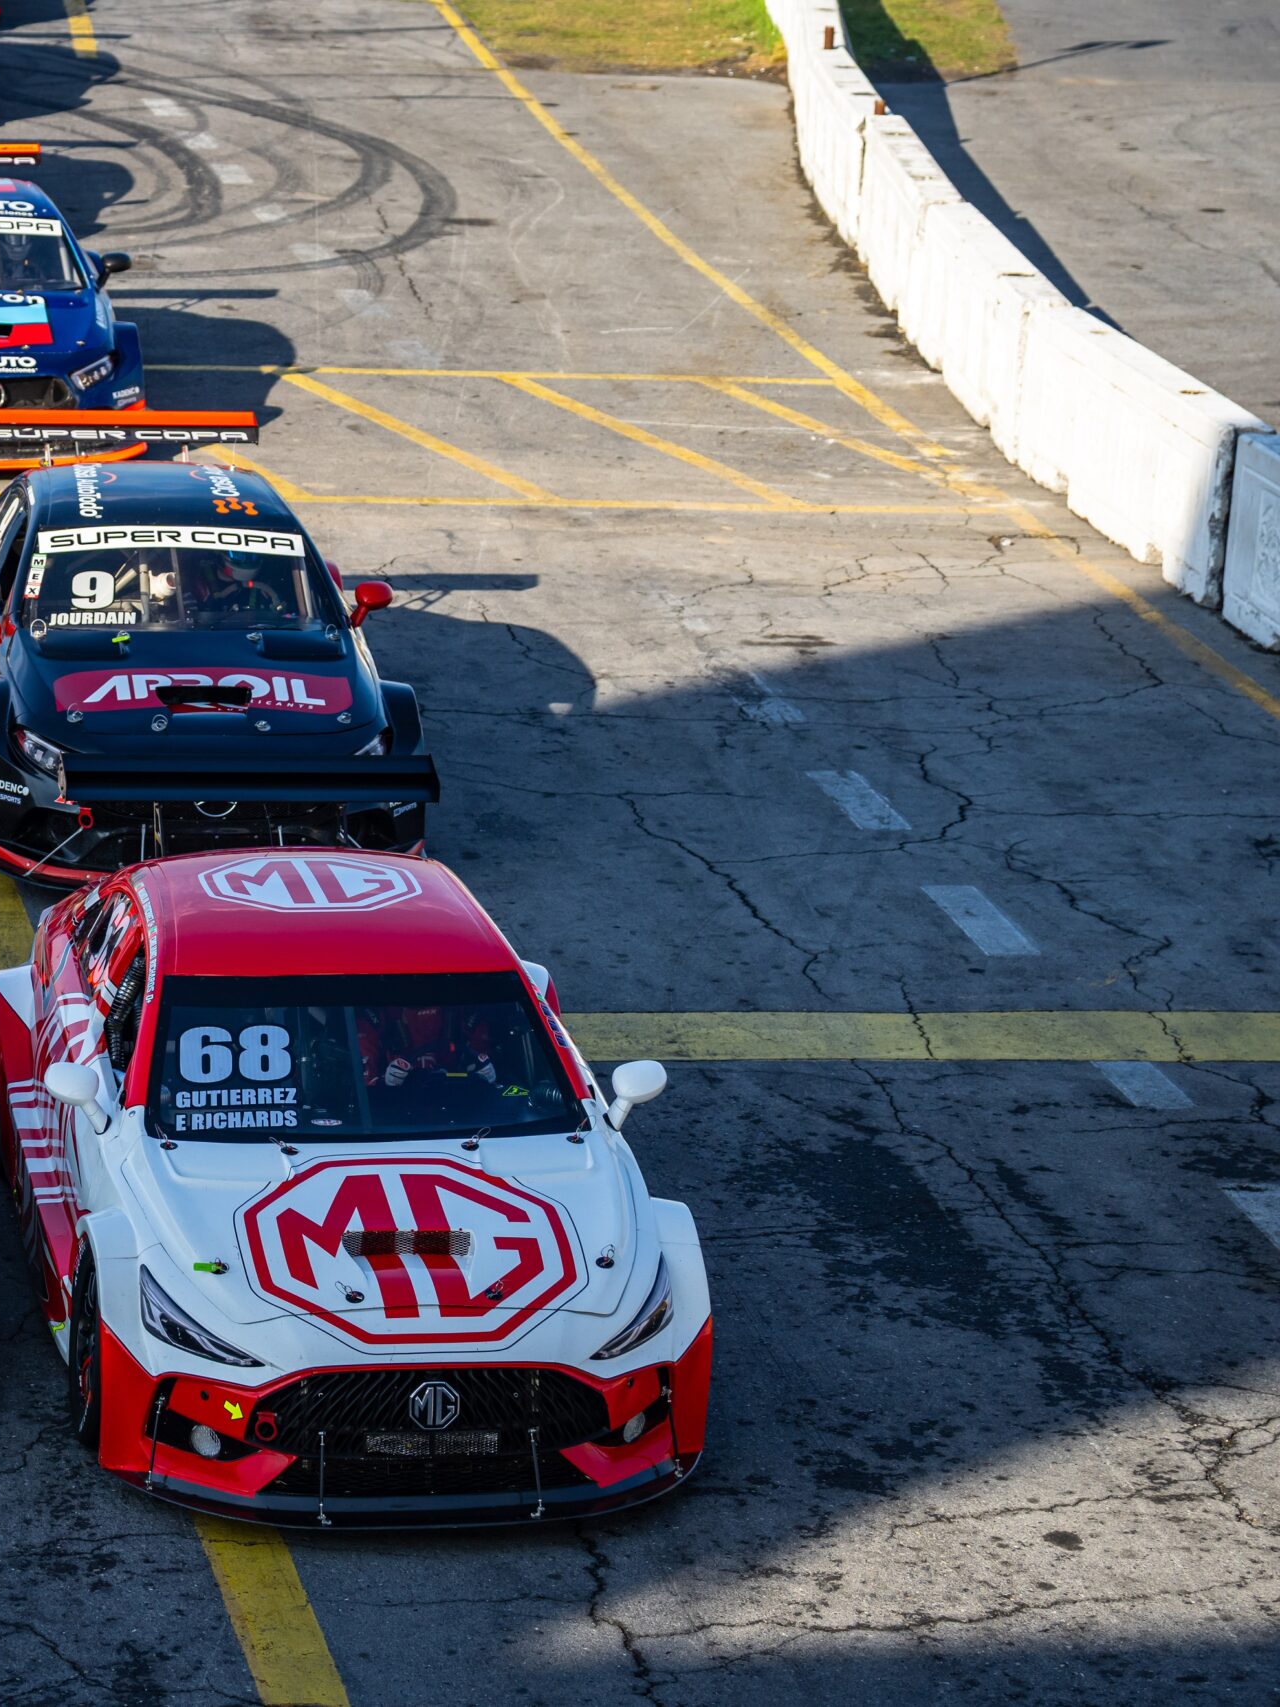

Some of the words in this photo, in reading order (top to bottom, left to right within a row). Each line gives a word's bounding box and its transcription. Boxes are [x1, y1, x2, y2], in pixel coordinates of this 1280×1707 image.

[134, 429, 249, 441] COPA
[49, 529, 183, 549] SUPER
[190, 530, 296, 551] COPA
[71, 570, 115, 610] 9
[48, 611, 137, 627] JOURDAIN
[218, 861, 405, 905] MG
[177, 1025, 293, 1083] 68
[175, 1087, 297, 1108] GUTIERREZ
[175, 1114, 186, 1132] E
[191, 1110, 298, 1130] RICHARDS
[275, 1173, 546, 1319] MG
[414, 1386, 455, 1425] MG
